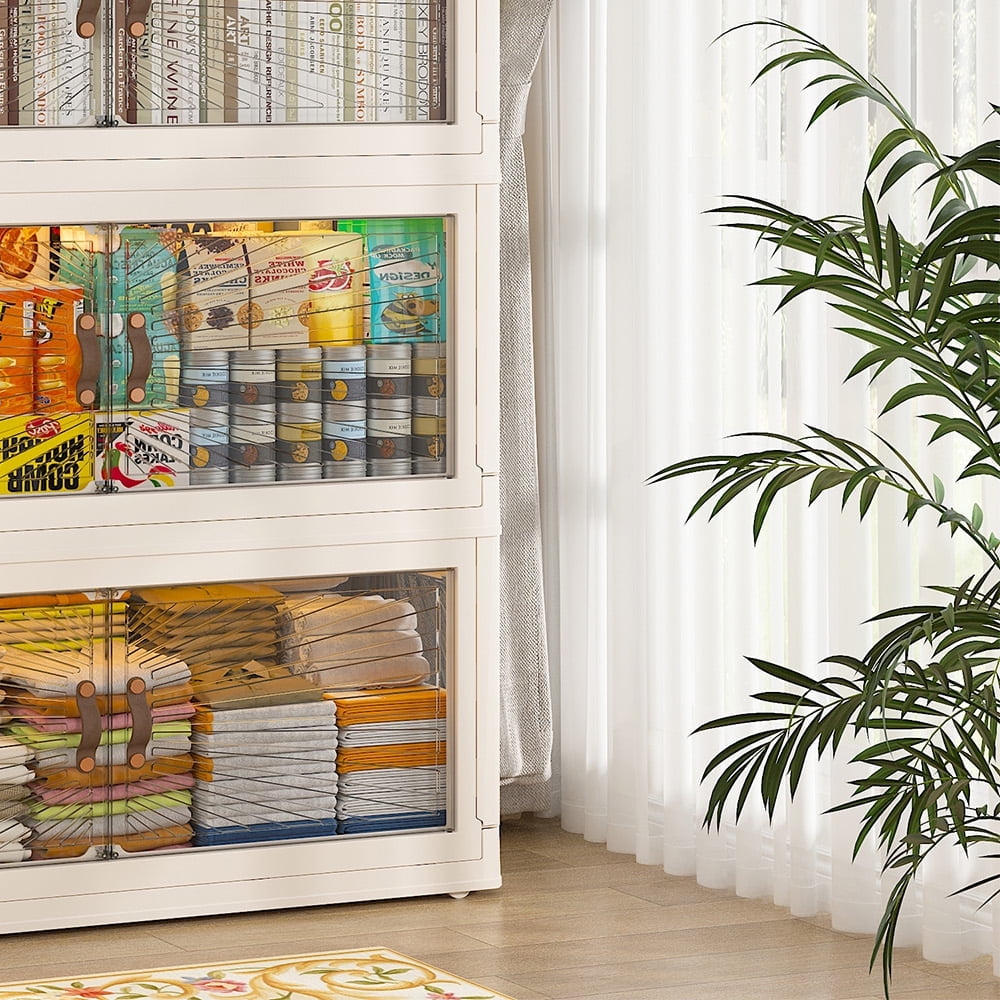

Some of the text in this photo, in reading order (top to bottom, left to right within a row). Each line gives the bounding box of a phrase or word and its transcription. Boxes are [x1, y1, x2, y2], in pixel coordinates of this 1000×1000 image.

[21, 22, 32, 60] FISH
[226, 15, 237, 45] ART
[240, 15, 250, 46] ART
[265, 30, 273, 63] DESIGN
[356, 15, 365, 54] BOOK
[117, 28, 126, 114] Gardens in France
[37, 71, 47, 126] SYMBO
[167, 60, 179, 125] WINE
[356, 68, 365, 122] SYMBO
